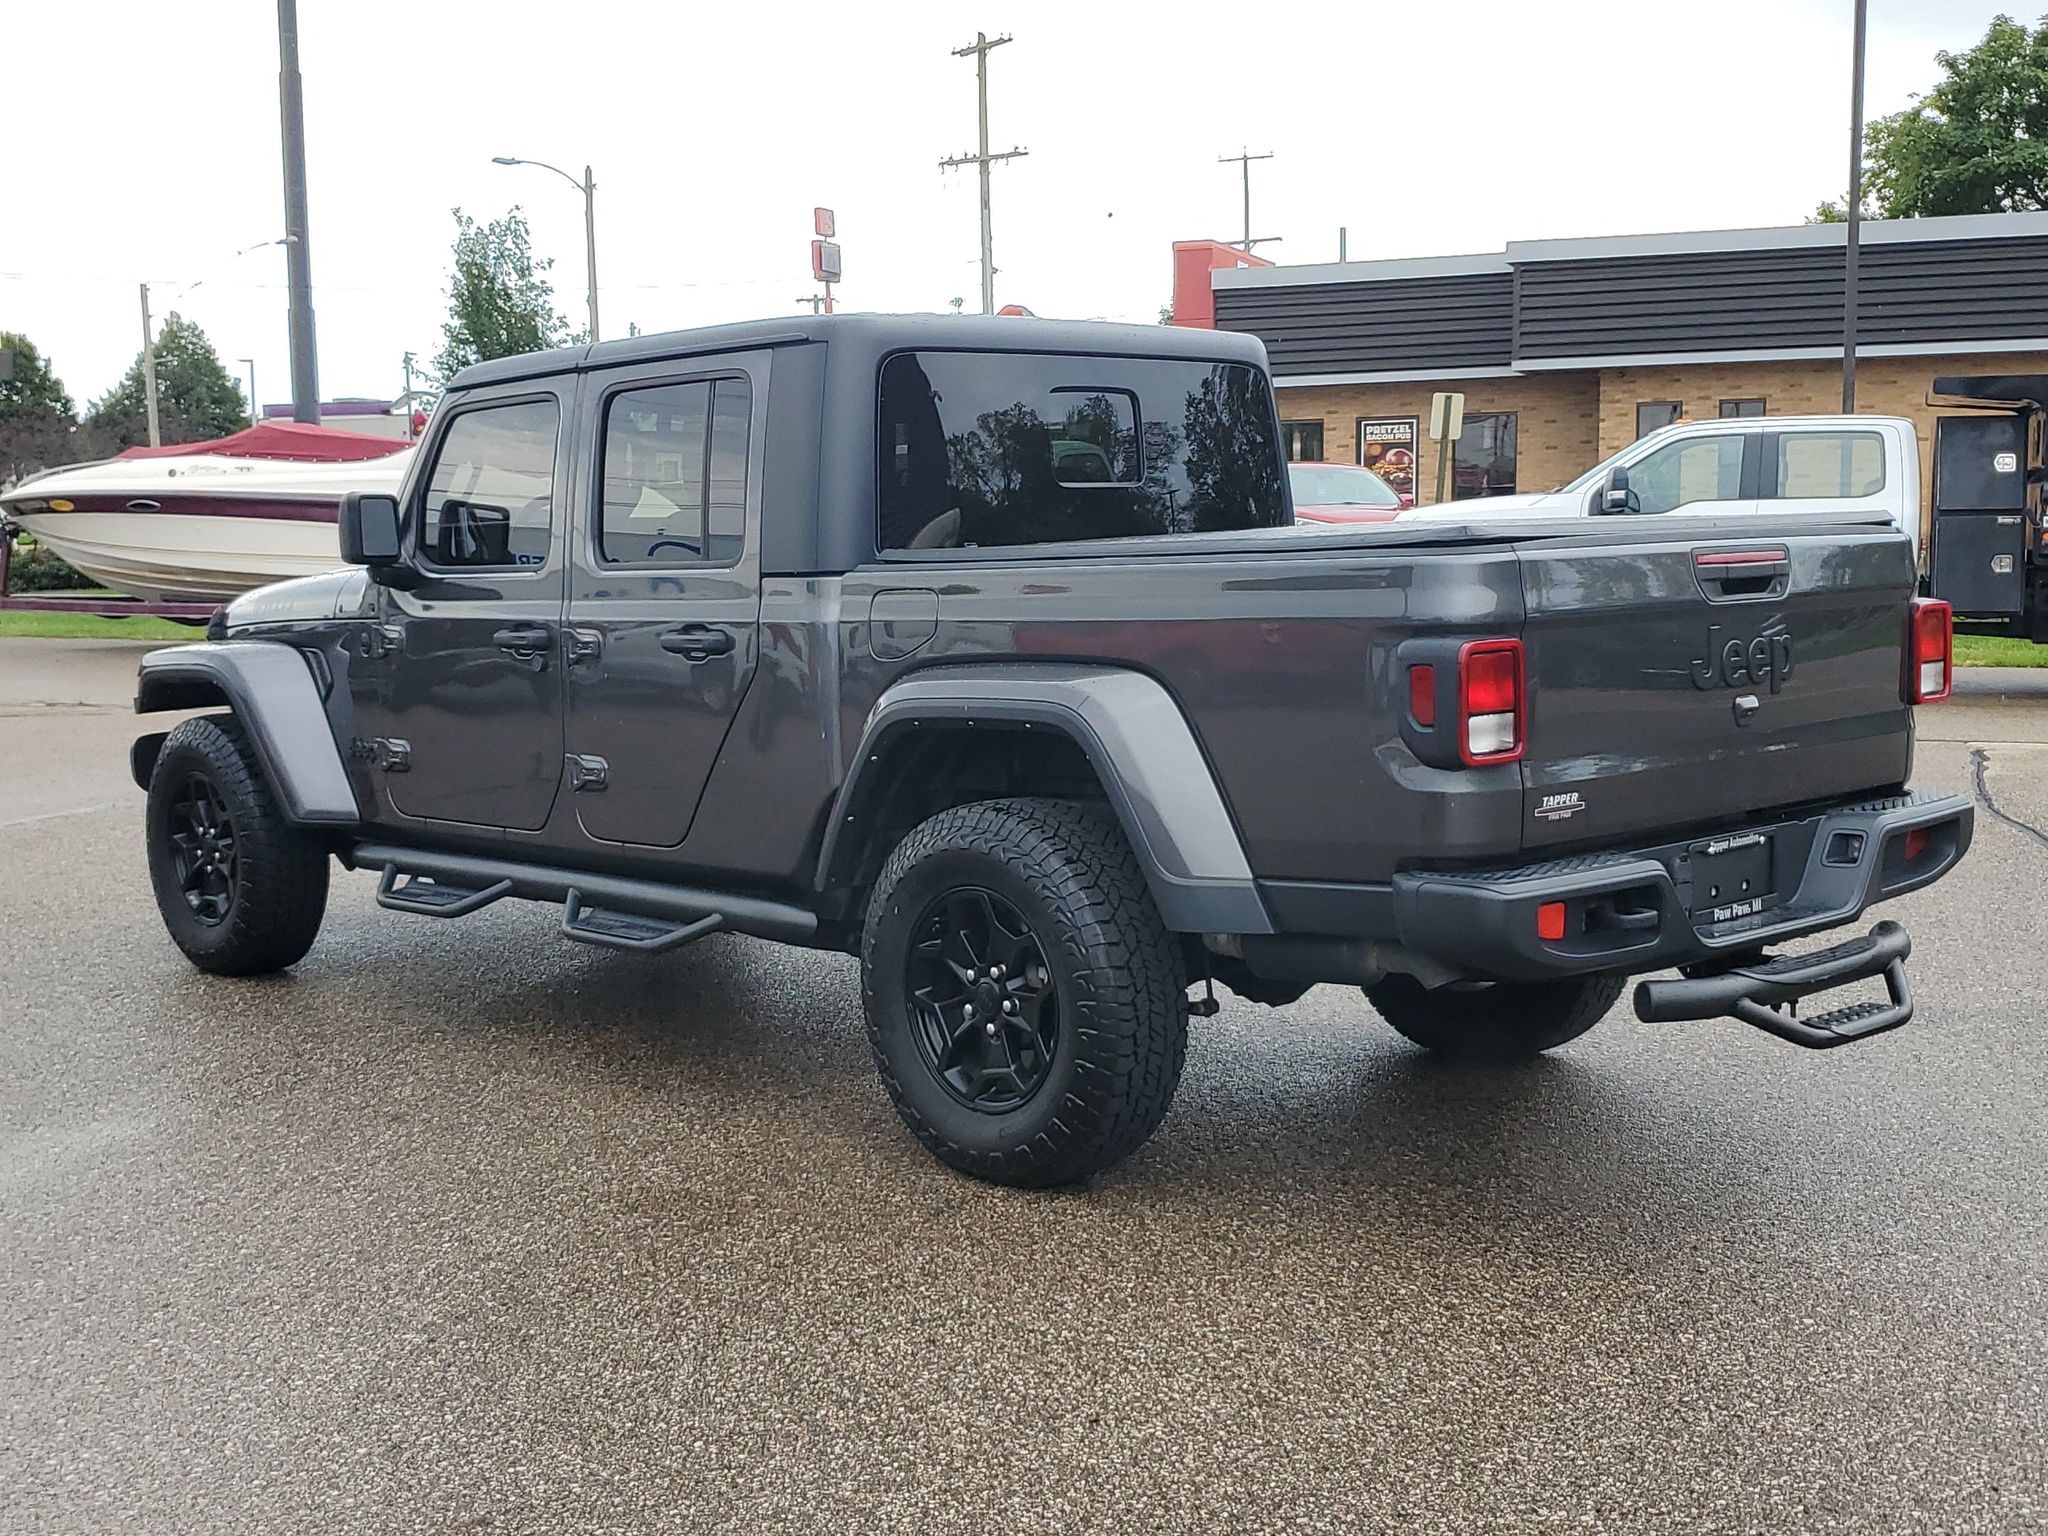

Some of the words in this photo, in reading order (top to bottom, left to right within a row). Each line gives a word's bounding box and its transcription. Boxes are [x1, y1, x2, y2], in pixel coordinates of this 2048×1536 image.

[1366, 424, 1411, 434] PRETZEL
[1395, 432, 1411, 440] PUB
[1690, 624, 1794, 694] Jeep
[1542, 792, 1579, 807] TAPPER
[1714, 908, 1731, 922] Paw
[1752, 898, 1762, 912] MI
